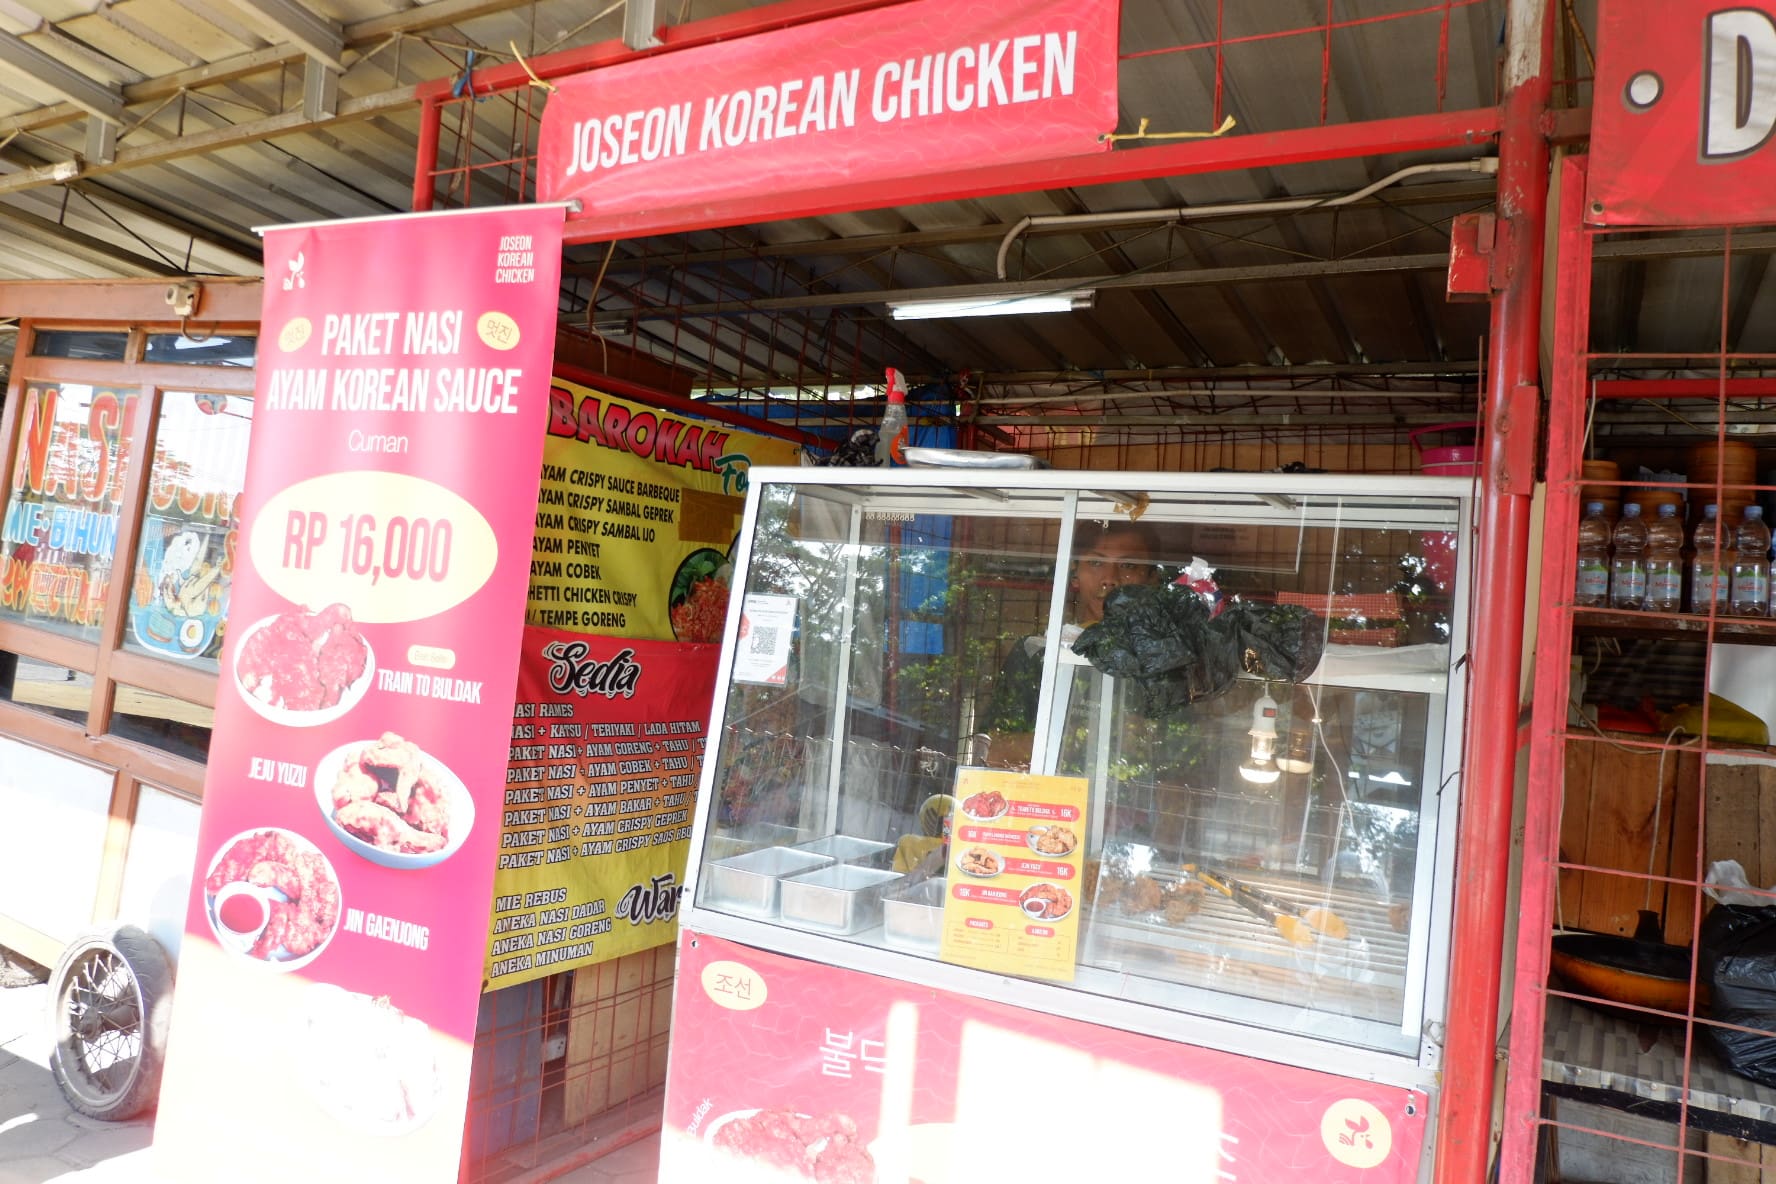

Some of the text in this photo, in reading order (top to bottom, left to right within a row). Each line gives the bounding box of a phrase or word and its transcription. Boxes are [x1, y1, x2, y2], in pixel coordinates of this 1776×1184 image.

[1697, 6, 1776, 165] D
[566, 31, 1077, 176] JOSEON KOREAN CHICKEN
[499, 235, 533, 251] JOSEON
[495, 268, 534, 283] CHICKEN
[497, 252, 533, 267] KOREAN
[321, 310, 463, 356] PAKET NASI
[485, 319, 513, 345] 멋진
[265, 368, 522, 414] AYAM KOREAN SAUCE
[12, 387, 140, 506] NASI
[348, 429, 409, 453] Cuman
[548, 385, 751, 496] BAROKAH Fo
[541, 463, 680, 503] YAM CRISPY SAUCE BARBEQUE
[538, 488, 673, 525] YAM CRISPY SAMBAL GEPREK
[568, 516, 600, 537] CRISPY
[601, 521, 640, 541] SAMBAL
[642, 526, 655, 543] IJO
[282, 510, 328, 570] RP
[339, 513, 453, 586] 16,000
[532, 536, 600, 559] AYAM PENYET
[530, 560, 602, 580] AYAM COBEK
[528, 585, 637, 608] HETTI CHICKEN CRISPY
[540, 609, 579, 626] TEMPE
[581, 611, 626, 628] GORENG
[378, 668, 483, 704] TRAIN TO BULDAK
[542, 641, 641, 699] Sedia
[514, 703, 574, 718] ASI RAMES
[538, 727, 546, 736] +
[550, 724, 582, 739] KATSU
[592, 723, 635, 738] TERIYAKI
[644, 721, 668, 736] LADA
[670, 720, 701, 734] HITAM
[508, 745, 545, 761] PAKET
[549, 744, 577, 759] NASI
[586, 743, 613, 757] AYAM
[615, 741, 653, 756] GORENG
[662, 739, 689, 752] TAHU
[248, 757, 308, 788] JEJU YUZU
[506, 766, 545, 783] PAKET
[548, 765, 576, 780] NASI
[587, 762, 617, 778] AYAM
[619, 758, 652, 774] COBEK
[662, 756, 688, 770] TAHU
[505, 787, 545, 804] PAKET
[547, 784, 573, 800] NASI
[577, 787, 585, 797] +
[588, 781, 617, 797] AYAM
[620, 778, 660, 795] PENYET
[670, 774, 694, 788] TAHU
[504, 809, 546, 826] PAKET
[549, 805, 571, 822] NASI
[574, 807, 582, 816] +
[585, 801, 617, 817] AYAM
[620, 798, 653, 814] BAKAR
[663, 793, 685, 808] TAHU
[502, 809, 688, 848] PAKET NASI + AYAM CRISPY GEPREK
[499, 852, 544, 870] PAKET
[546, 847, 571, 865] NASI
[581, 841, 612, 857] AYAM
[615, 835, 650, 853] CRISPY
[652, 831, 675, 848] SAOS
[495, 887, 567, 913] MIE REBUS
[343, 907, 430, 951] JIN GAENJONG
[493, 899, 605, 934] ANEKA NASI DADAR
[491, 917, 612, 956] ANEKA NASI GORENG
[491, 941, 593, 978] ANEKA MINUMAN
[714, 973, 751, 1000] 조선
